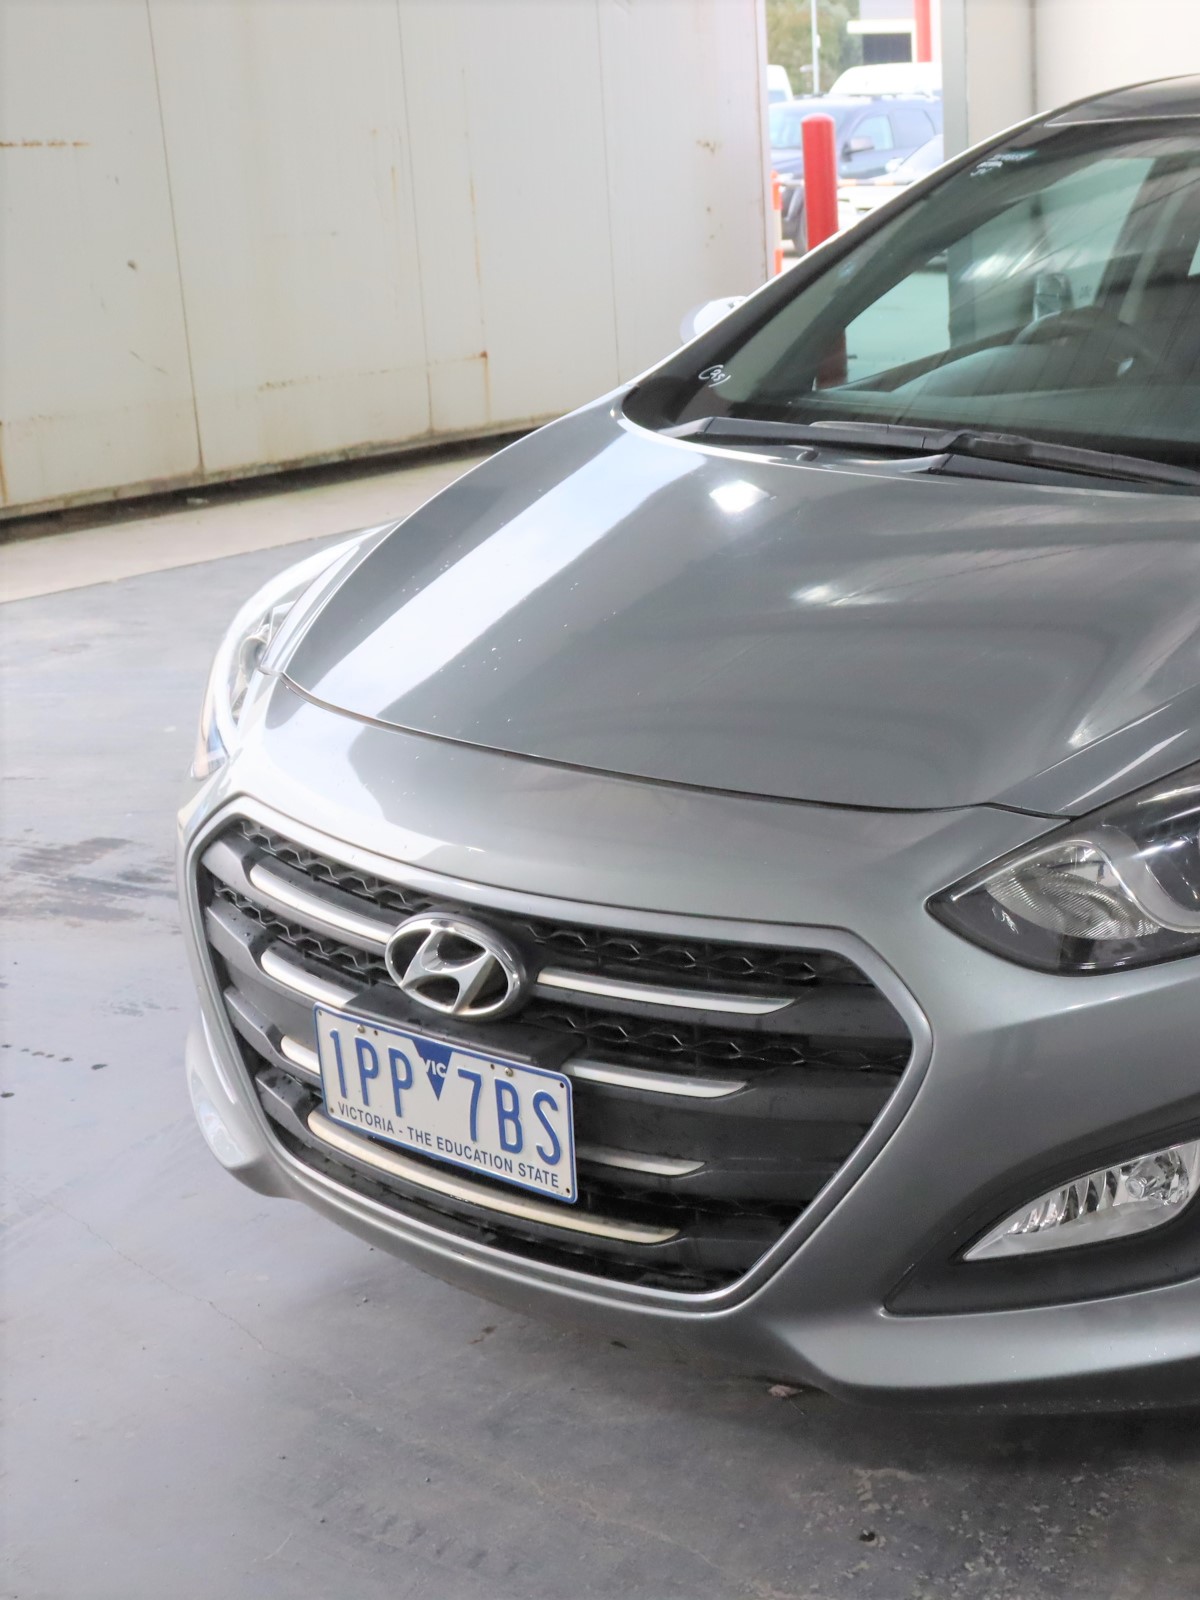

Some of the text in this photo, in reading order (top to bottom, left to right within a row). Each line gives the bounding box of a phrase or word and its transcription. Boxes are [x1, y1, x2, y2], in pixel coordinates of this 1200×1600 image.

[329, 1028, 561, 1166] 1PP 7BS
[421, 1056, 447, 1079] VIC
[337, 1101, 395, 1134] VICTORIA
[407, 1126, 432, 1147] THE
[436, 1136, 513, 1173] EDUCATION
[518, 1162, 559, 1188] STATE
